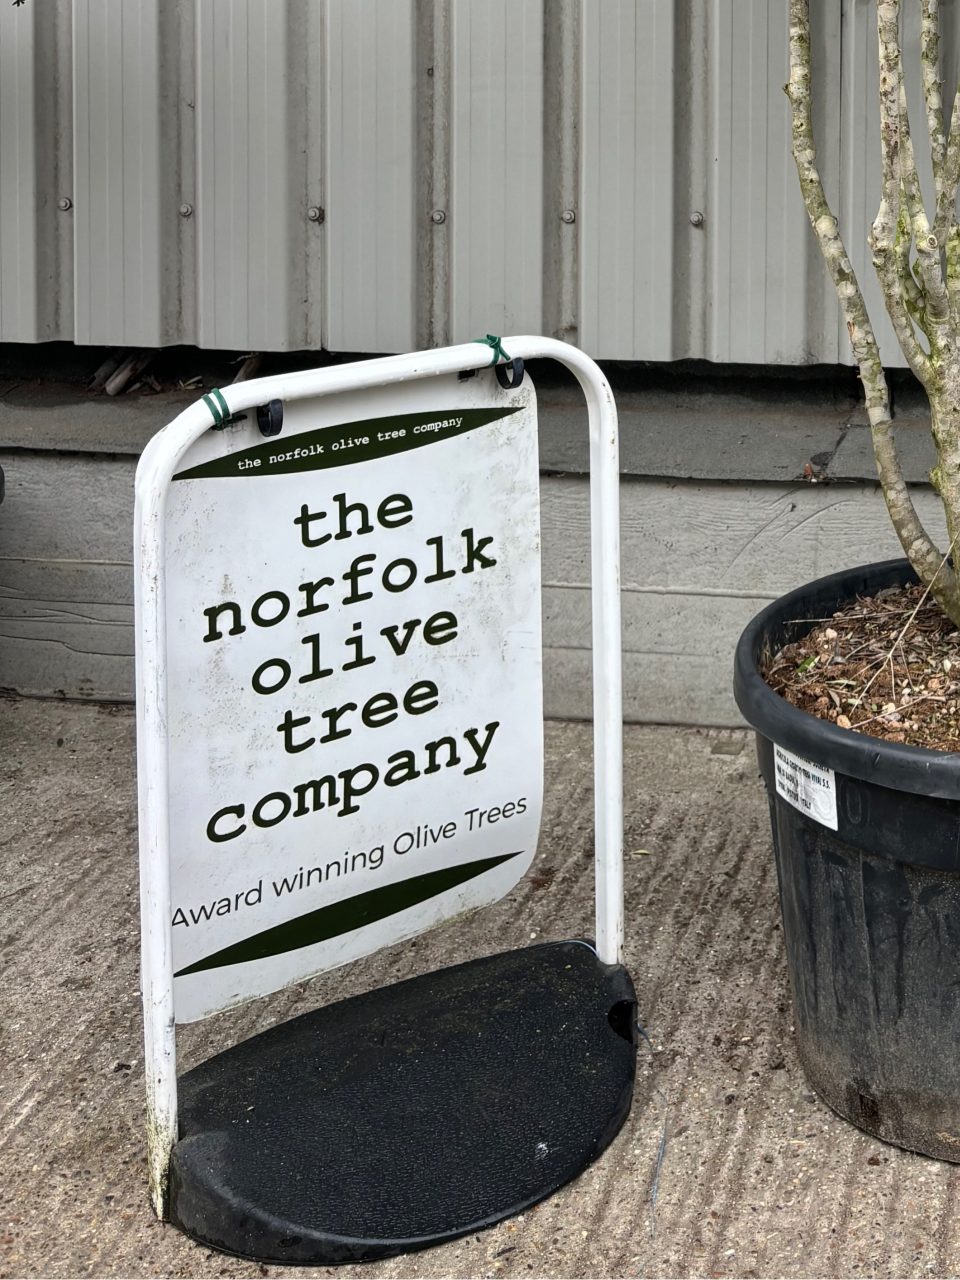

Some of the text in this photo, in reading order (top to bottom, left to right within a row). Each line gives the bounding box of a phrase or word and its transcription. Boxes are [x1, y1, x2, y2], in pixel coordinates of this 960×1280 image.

[237, 416, 464, 470] the norfolk olive tree company
[293, 492, 413, 548] the
[202, 527, 498, 643] norfolk
[251, 610, 458, 696] olive
[276, 680, 439, 754] tree
[206, 721, 500, 843] company
[171, 797, 528, 928] Award winning Olive Trees
